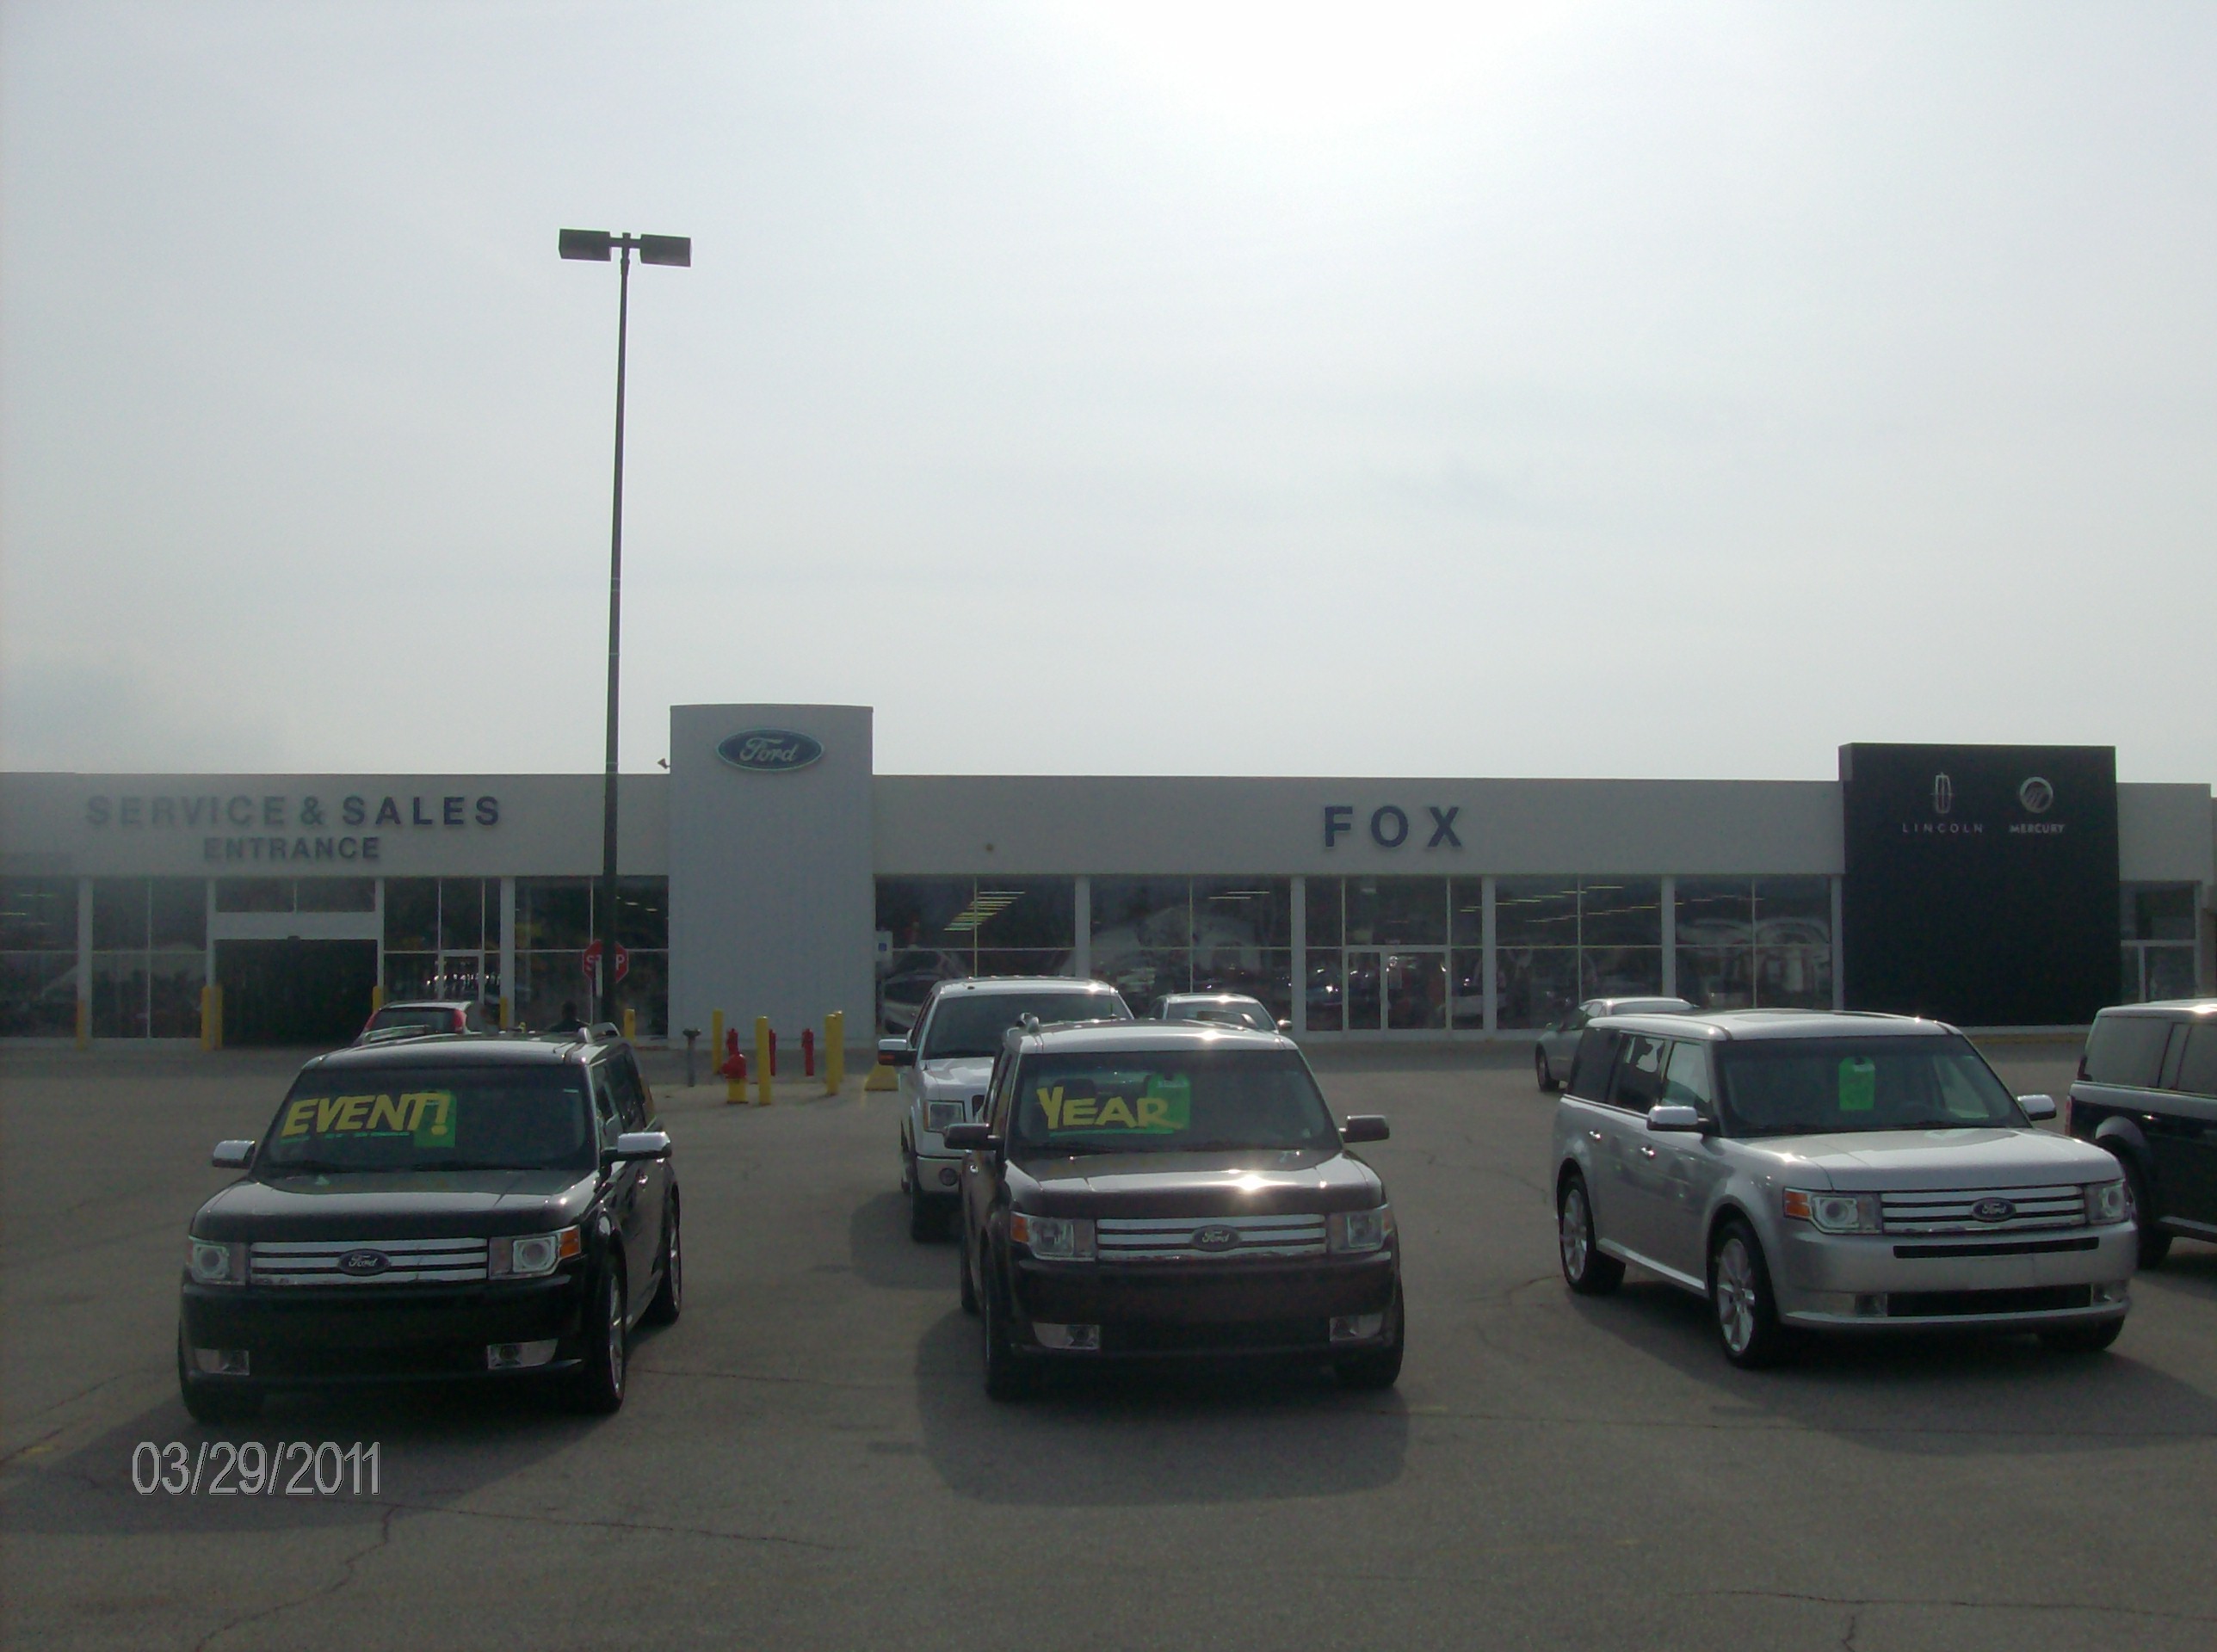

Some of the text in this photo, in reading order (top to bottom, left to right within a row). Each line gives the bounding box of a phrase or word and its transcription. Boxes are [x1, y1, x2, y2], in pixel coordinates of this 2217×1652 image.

[740, 737, 800, 762] Ford
[87, 795, 499, 826] SERVICE & SALES
[1325, 805, 1461, 848] FOX
[1903, 823, 1983, 833] LINCOLN
[2010, 823, 2065, 833] MERCURY
[204, 836, 380, 860] ENTRANCE
[586, 953, 625, 971] SP
[281, 1092, 451, 1137] EVENT!
[1036, 1086, 1185, 1130] YEAR
[1982, 1203, 2007, 1214] Ford
[1202, 1231, 1230, 1243] Ford
[349, 1254, 378, 1267] Ford
